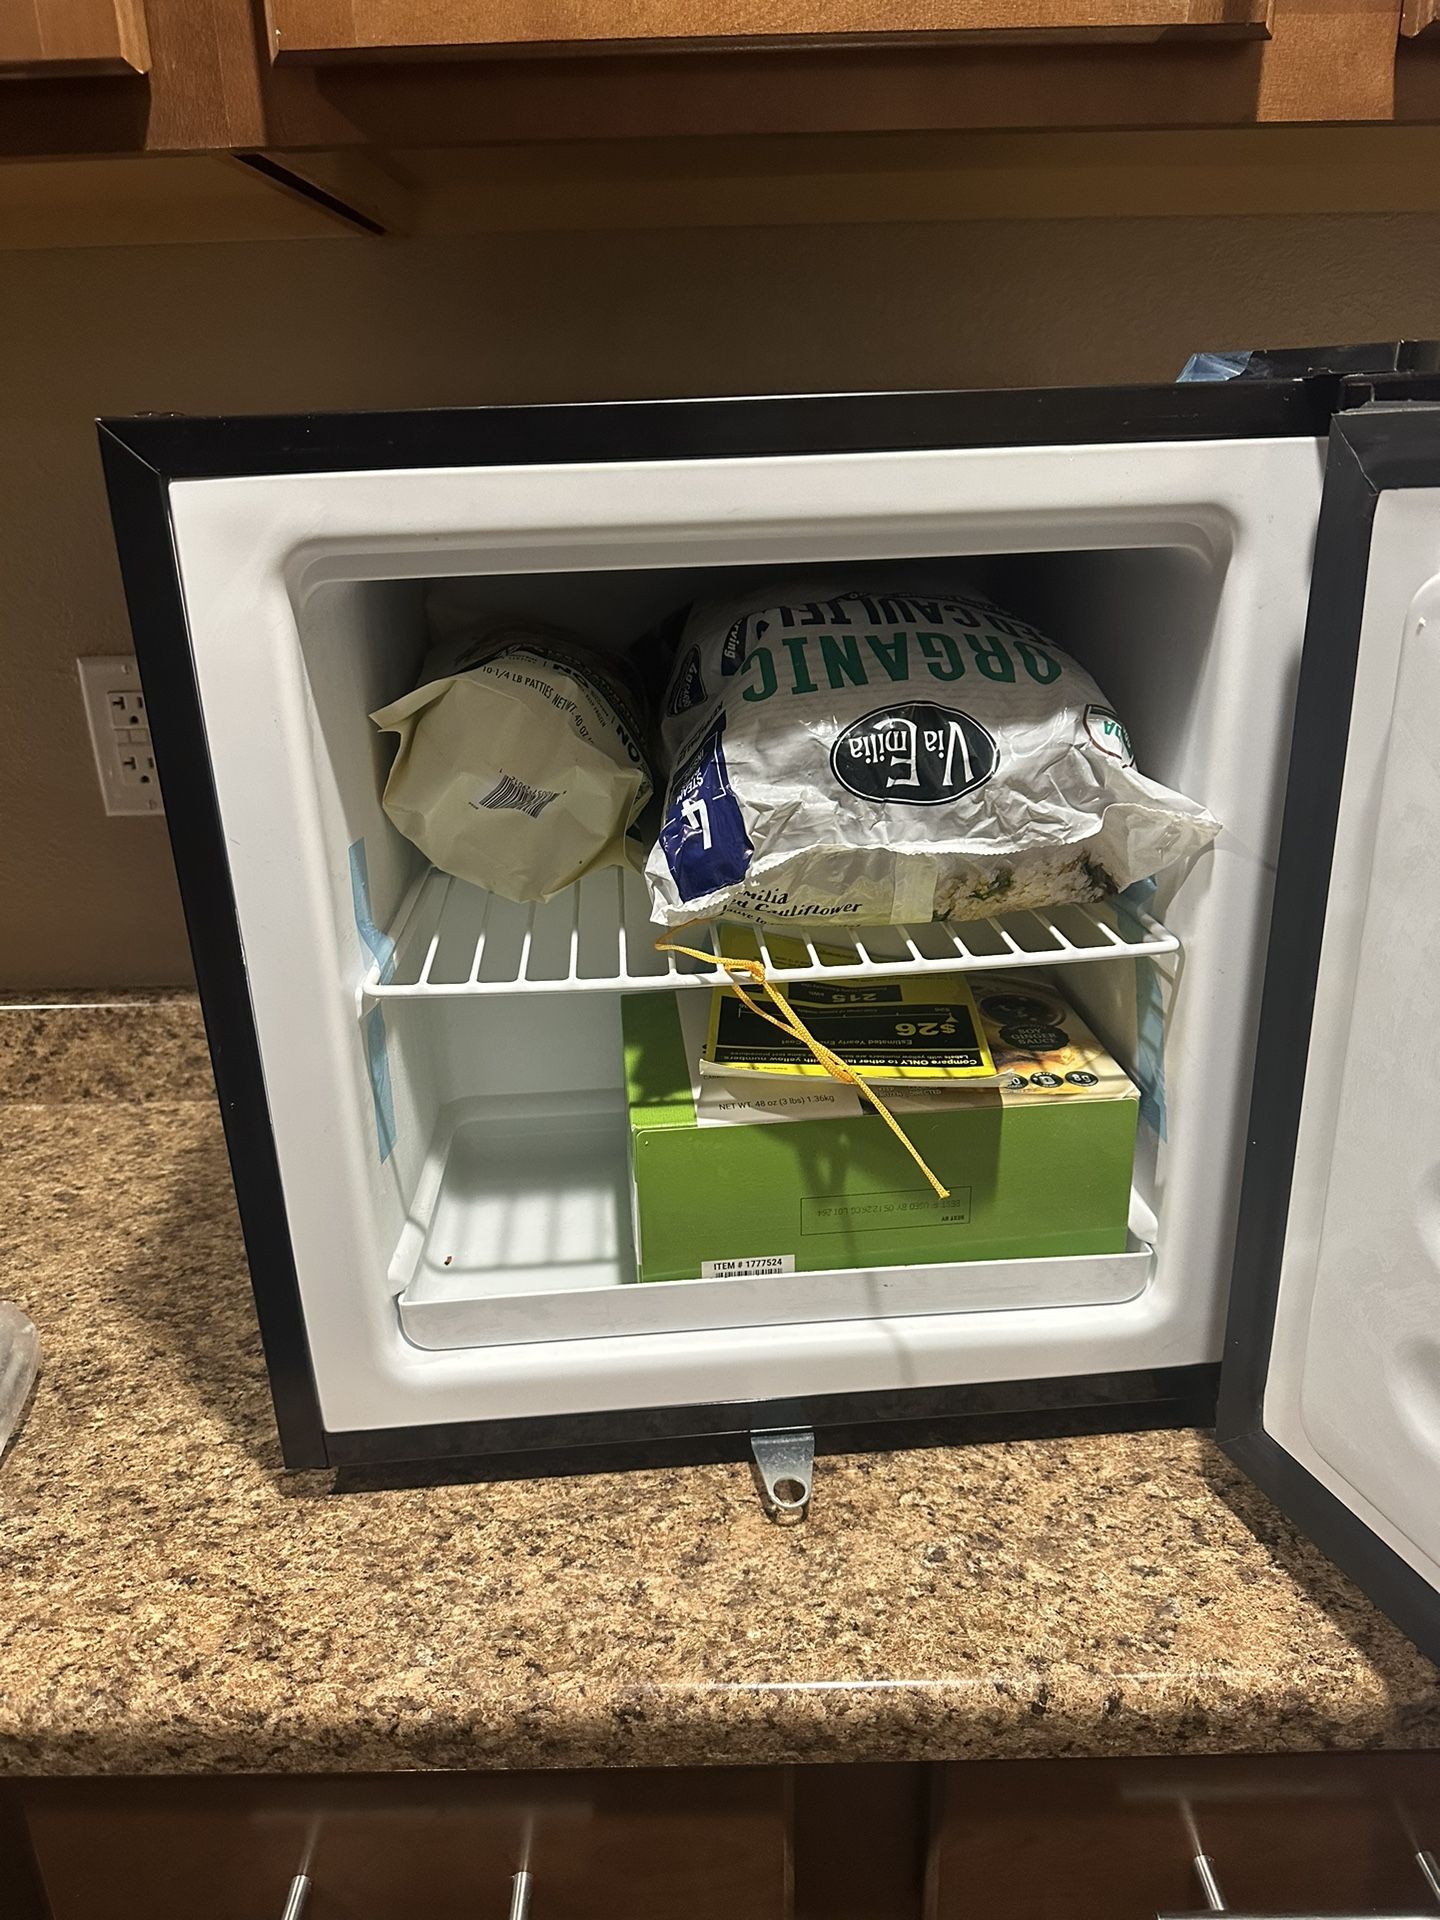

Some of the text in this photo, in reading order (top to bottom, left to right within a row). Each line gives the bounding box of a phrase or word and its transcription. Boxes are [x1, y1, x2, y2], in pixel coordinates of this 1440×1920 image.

[742, 631, 1066, 703] ORGANIC
[511, 673, 523, 684] LB
[524, 677, 555, 700] PATTIES
[573, 714, 584, 727] 40
[578, 724, 590, 738] OZ
[615, 724, 641, 763] NO
[846, 717, 976, 790] Via Emilia
[674, 769, 706, 806] STEAM
[742, 887, 789, 905] milia
[830, 991, 879, 1003] 215
[893, 1020, 958, 1038] $26
[1017, 1027, 1042, 1035] SOY
[868, 1036, 914, 1047] Estimated
[1009, 1032, 1058, 1041] GINGER
[769, 1055, 803, 1064] yellow
[860, 1058, 886, 1066] other
[931, 1058, 978, 1067] Compare
[718, 1100, 738, 1111] NET
[754, 1099, 766, 1108] 48
[766, 1099, 778, 1107] oz
[778, 1098, 789, 1108] (3
[788, 1096, 806, 1108] lbs)
[806, 1094, 836, 1105] 1.36kg
[713, 1260, 736, 1271] ITEM
[745, 1257, 783, 1268] 1777524
